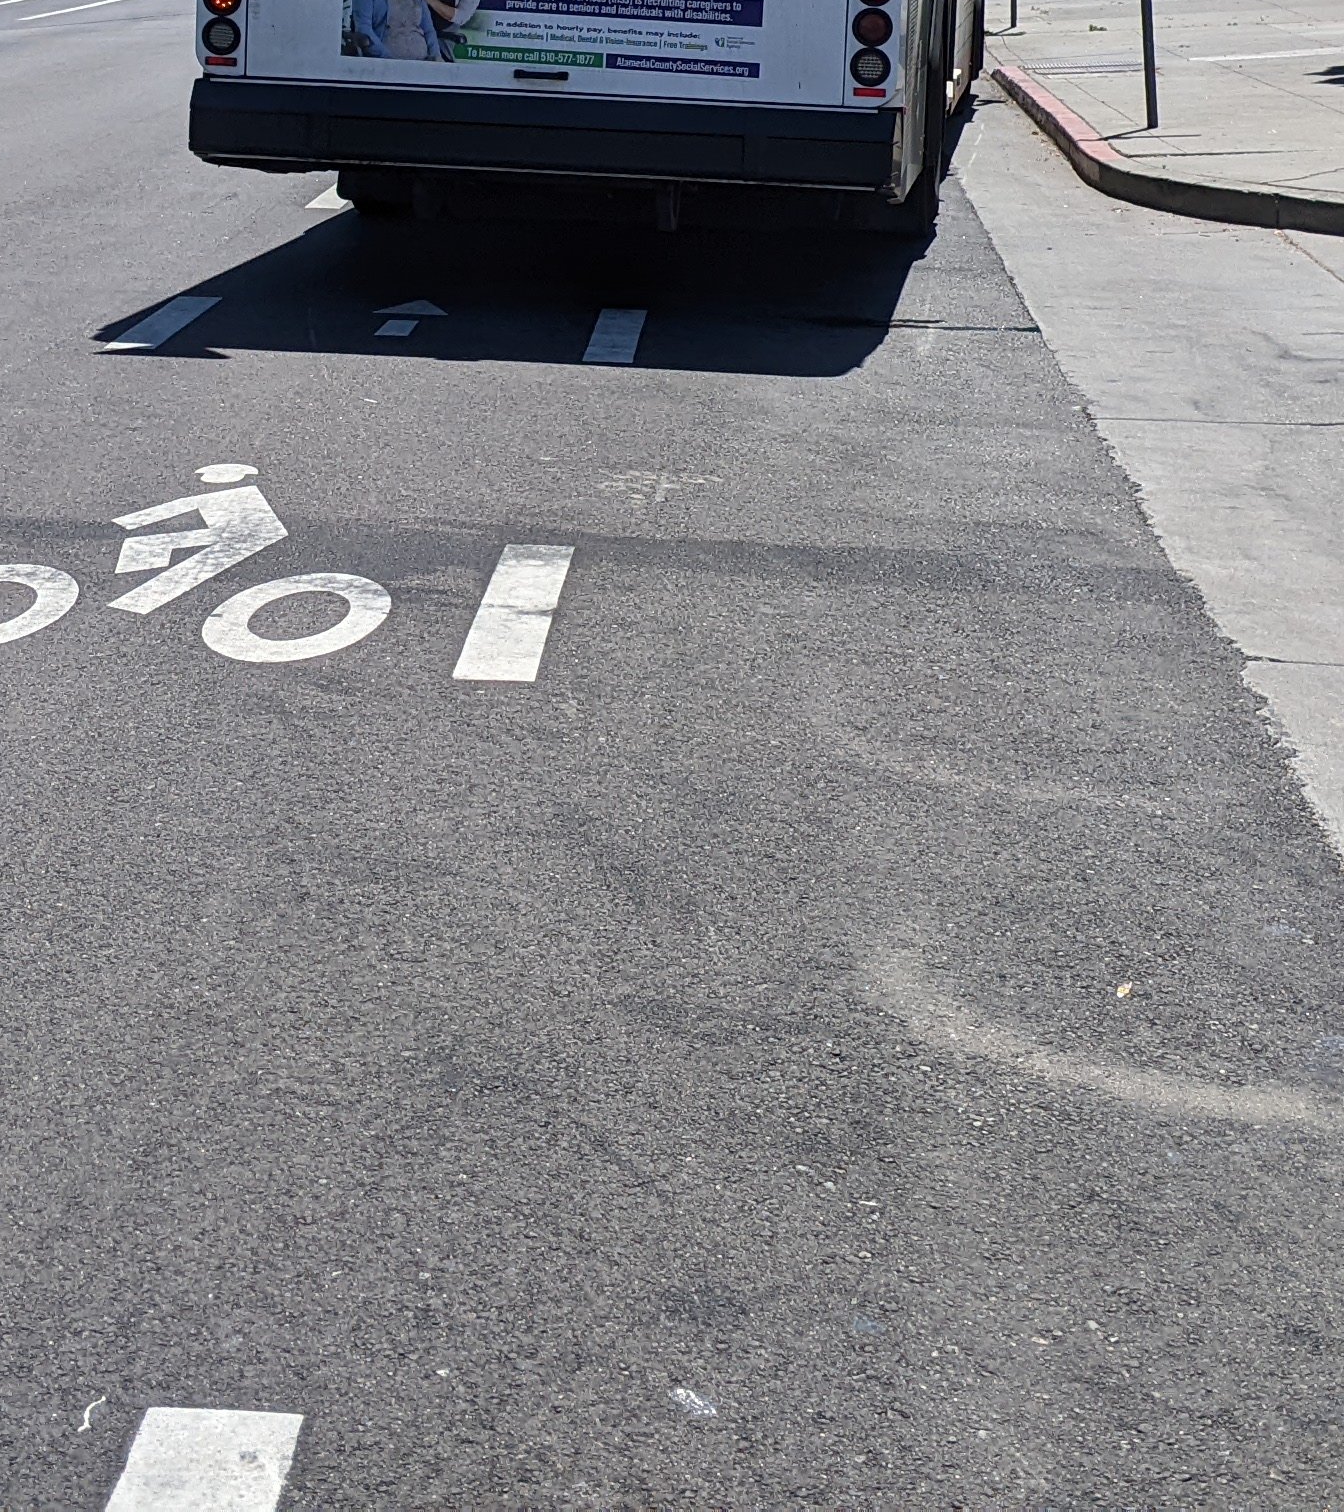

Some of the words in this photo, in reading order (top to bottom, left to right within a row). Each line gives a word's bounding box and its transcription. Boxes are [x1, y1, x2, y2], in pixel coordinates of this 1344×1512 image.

[506, 0, 537, 10] provide
[538, 2, 557, 10] care
[558, 1, 568, 11] to
[569, 3, 599, 13] seniors
[600, 4, 616, 15] and
[617, 5, 663, 18] individuals
[664, 7, 683, 19] with
[684, 9, 733, 22] disabilities.
[686, 0, 731, 12] caregivers
[732, 1, 742, 12] to
[506, 21, 542, 29] addition
[556, 23, 584, 33] hourly
[607, 27, 643, 36] benefits
[663, 40, 678, 49] Free
[466, 47, 477, 57] To
[478, 48, 500, 59] learn
[501, 51, 523, 61] more
[524, 51, 539, 61] call
[616, 56, 750, 76] AlamedaCountySocialServices.org
